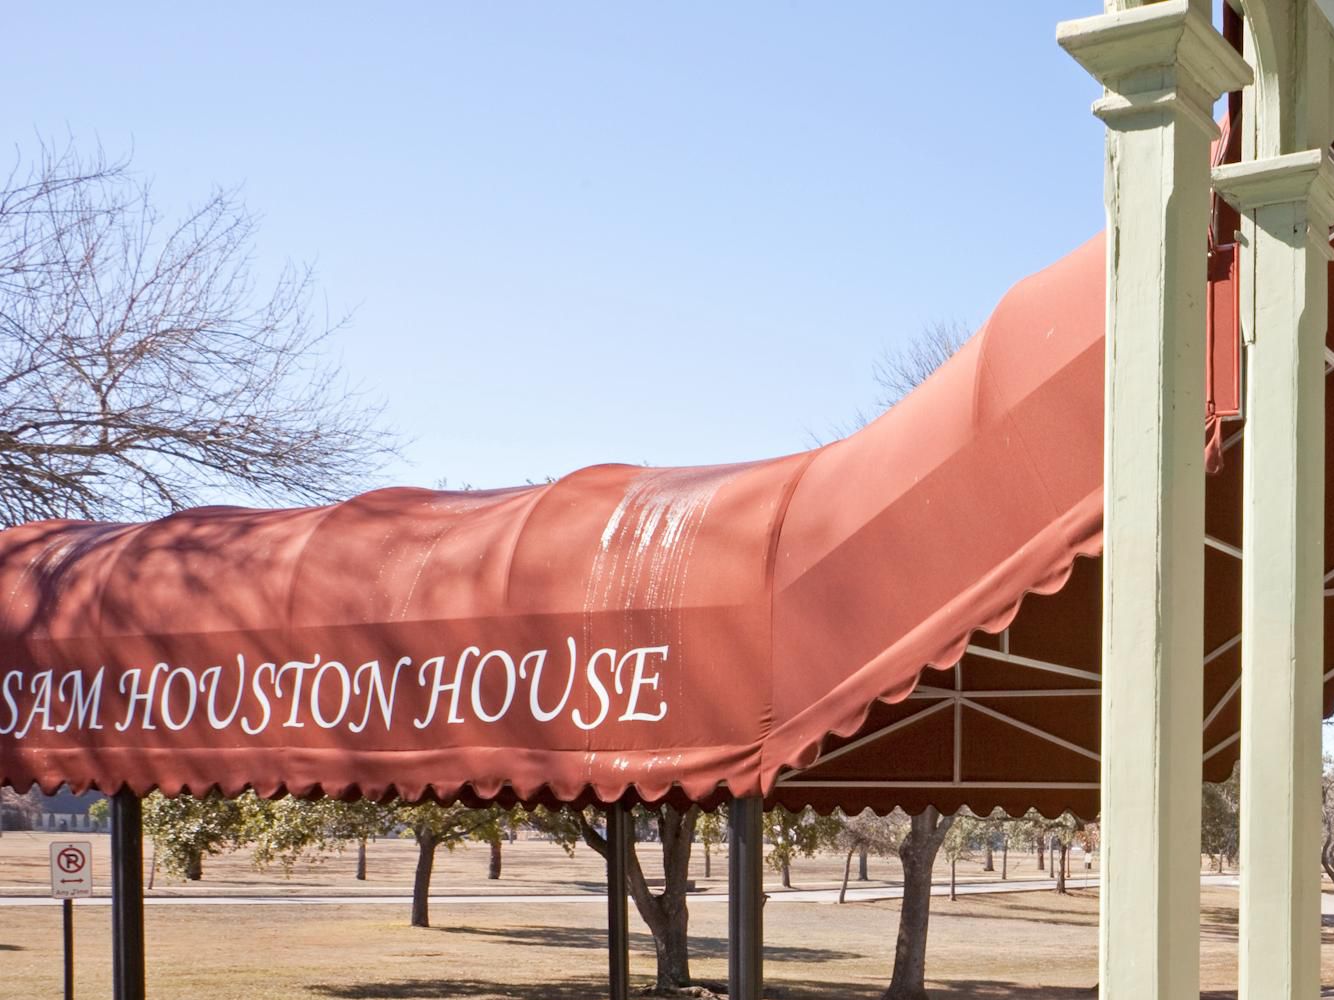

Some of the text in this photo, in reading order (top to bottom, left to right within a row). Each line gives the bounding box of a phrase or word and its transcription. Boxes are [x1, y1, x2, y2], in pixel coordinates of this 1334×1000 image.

[0, 636, 669, 740] SAM HOUSTON HOUSE
